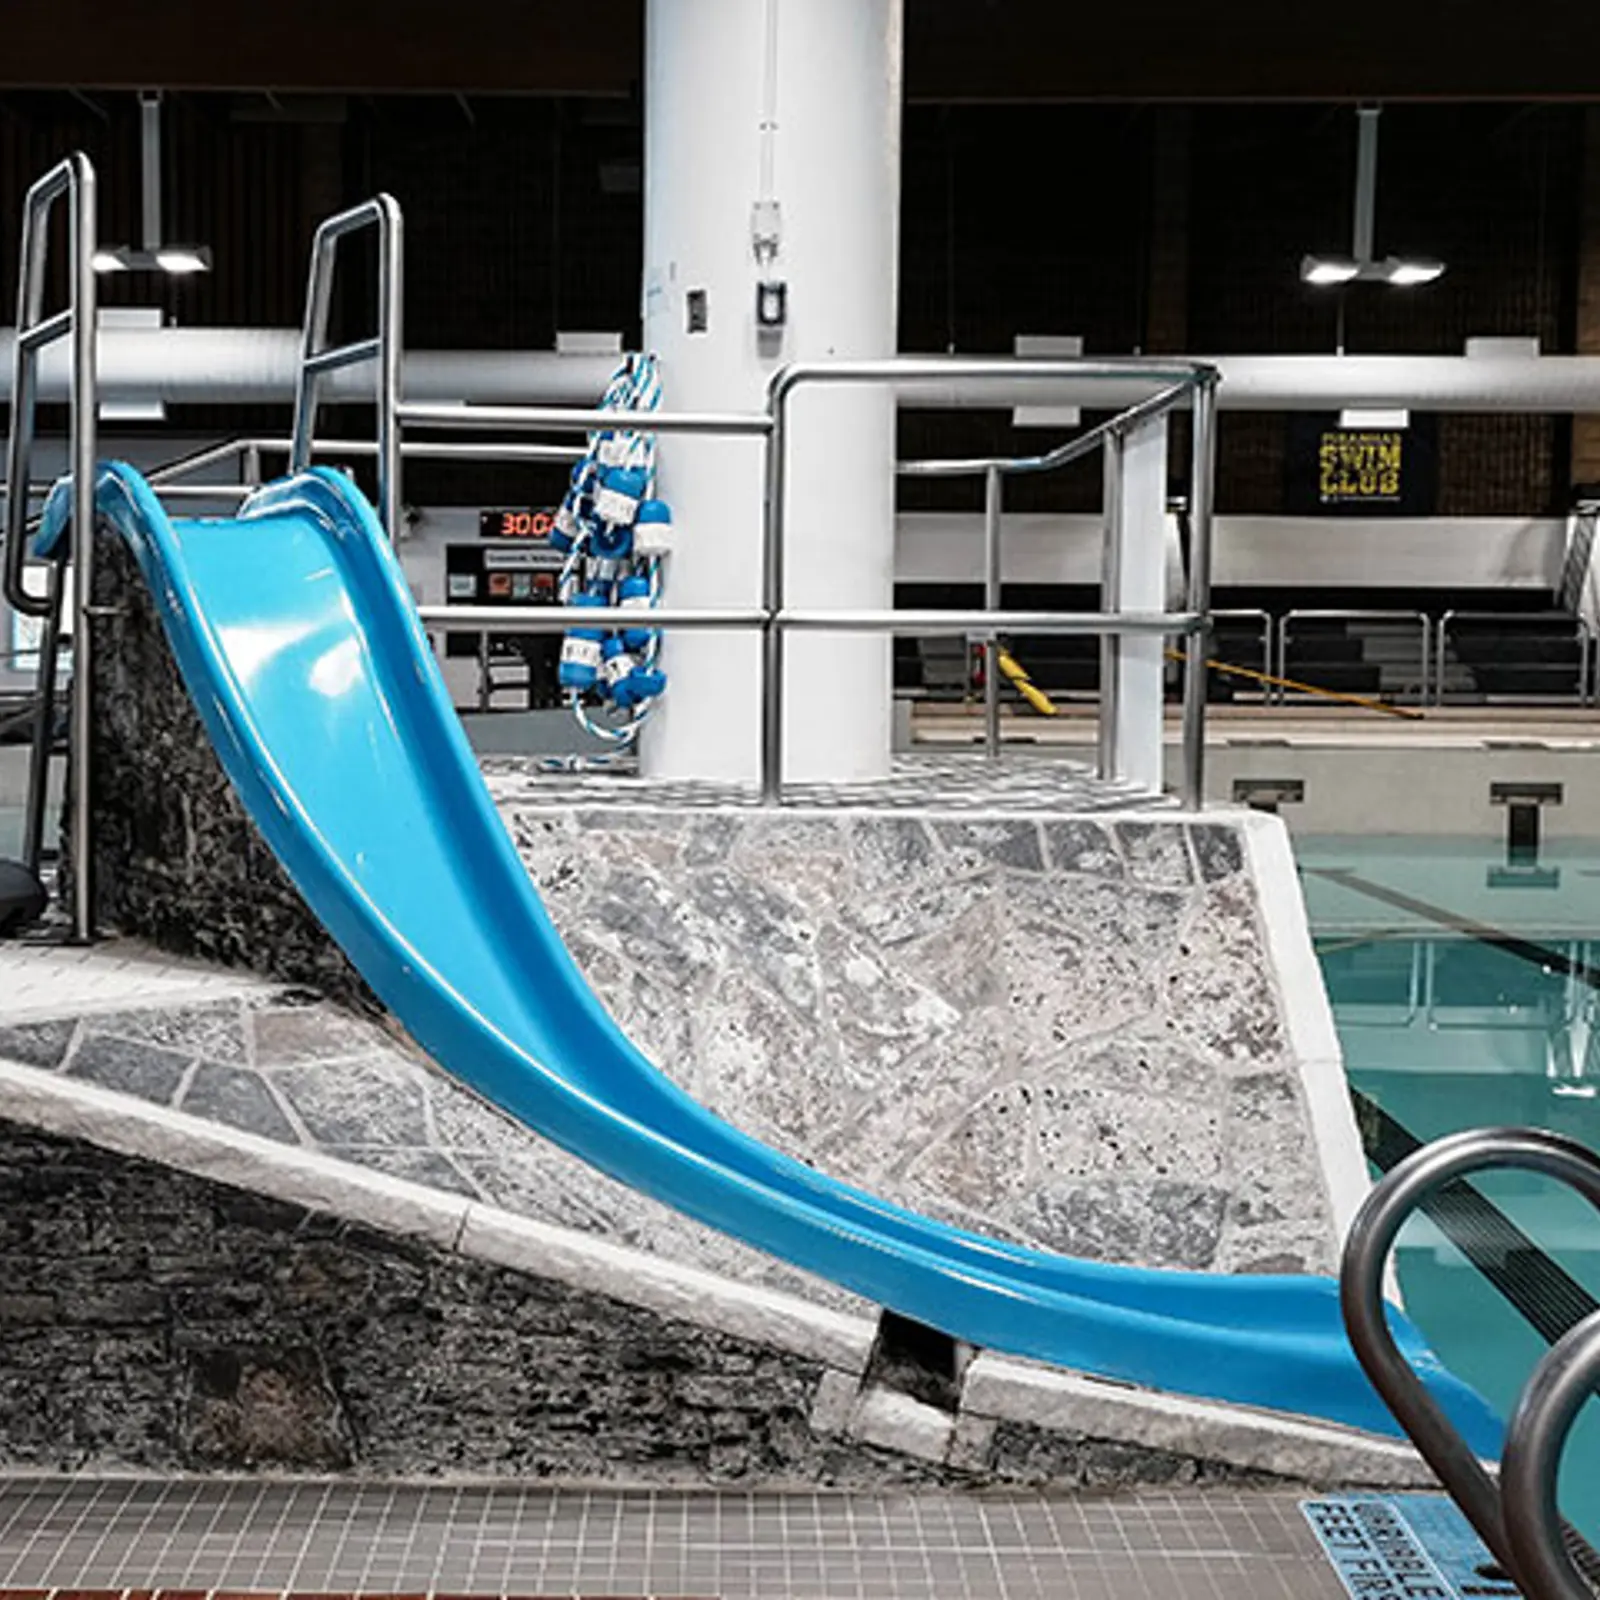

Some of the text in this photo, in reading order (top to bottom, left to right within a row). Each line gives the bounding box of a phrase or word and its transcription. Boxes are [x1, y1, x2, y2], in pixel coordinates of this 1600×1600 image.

[1320, 446, 1401, 470] SWIM
[1321, 470, 1399, 494] CLUB
[1307, 1502, 1369, 1550] FEET
